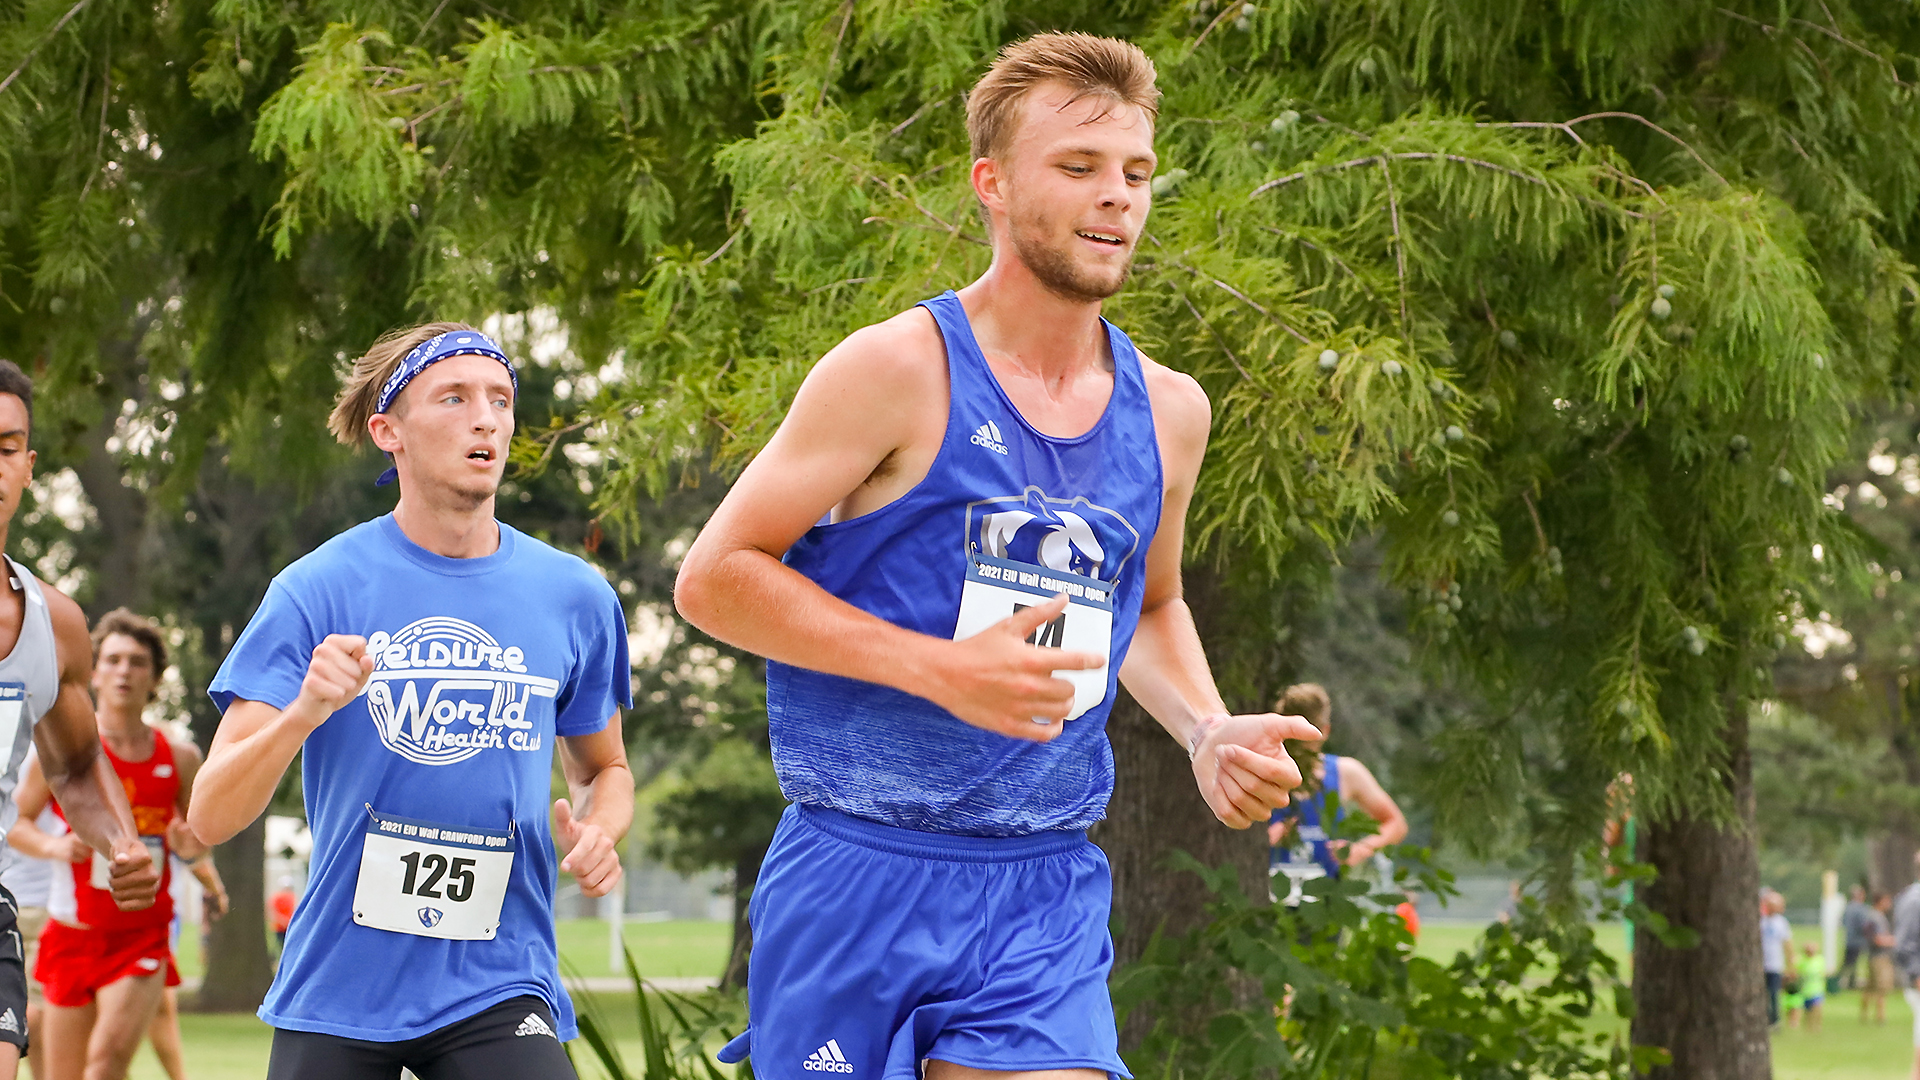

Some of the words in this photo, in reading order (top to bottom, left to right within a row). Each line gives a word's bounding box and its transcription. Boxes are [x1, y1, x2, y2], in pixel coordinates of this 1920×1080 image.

[970, 434, 1009, 456] adidas
[978, 563, 1002, 580] 2021
[1002, 568, 1018, 583] EIU
[1040, 576, 1084, 598] CRAWFORD
[1084, 586, 1106, 603] Open
[367, 680, 534, 744] World
[422, 725, 505, 751] Health
[508, 730, 542, 751] Club
[379, 820, 403, 834] 2021
[403, 824, 418, 836] EIU
[440, 830, 485, 845] CRAWFORD
[485, 835, 507, 848] Open
[400, 851, 477, 903] 125
[802, 1058, 854, 1074] adidas
